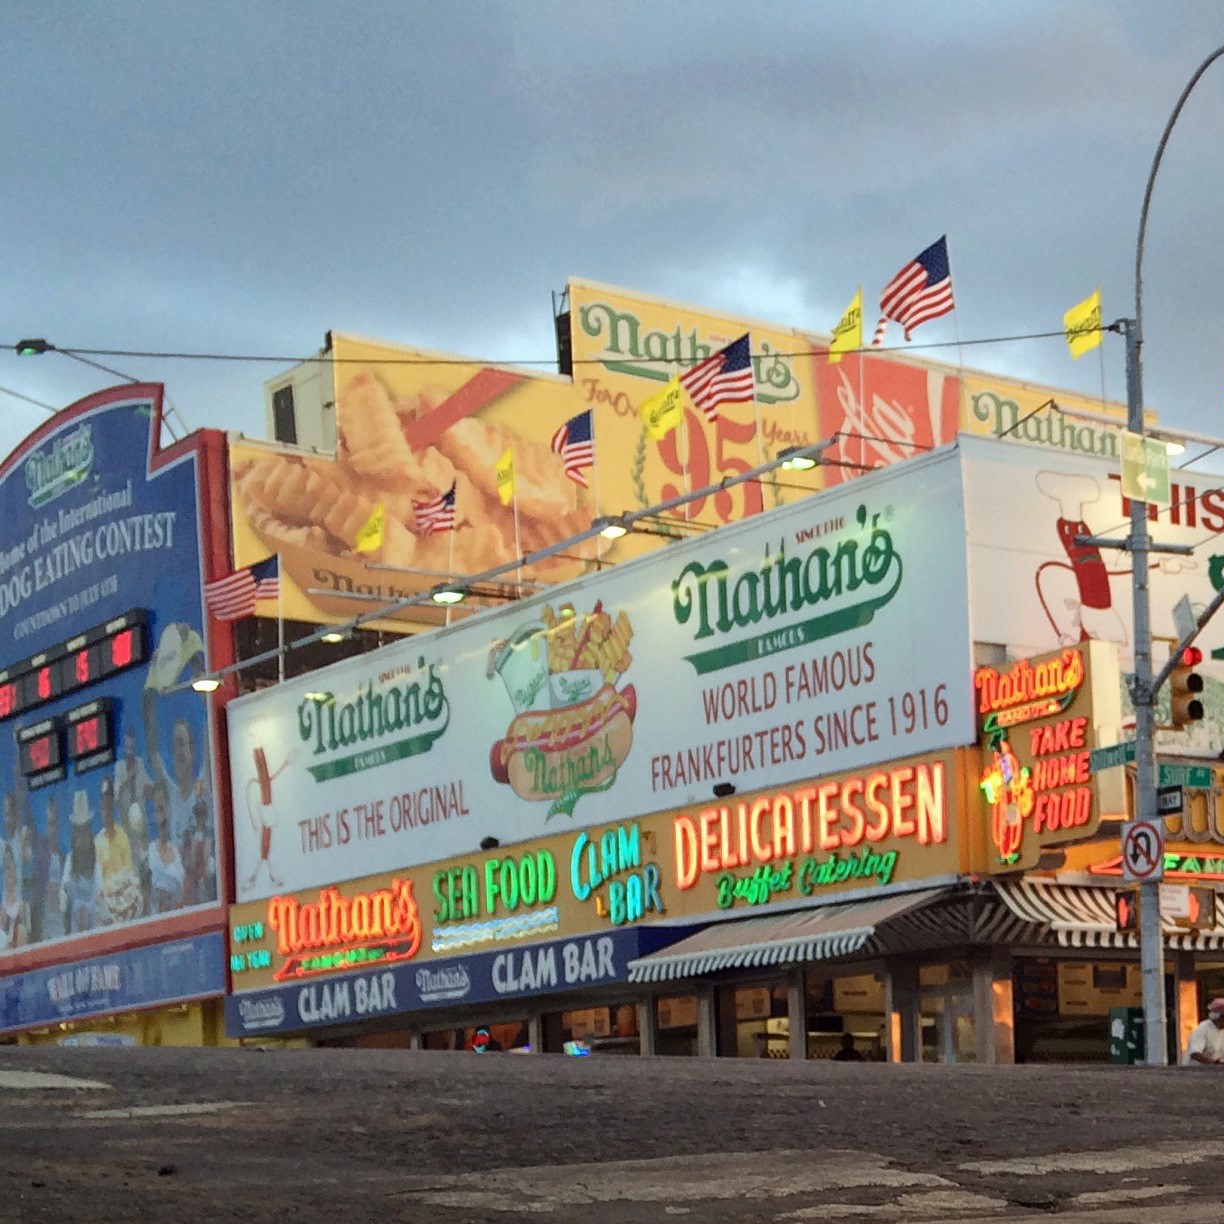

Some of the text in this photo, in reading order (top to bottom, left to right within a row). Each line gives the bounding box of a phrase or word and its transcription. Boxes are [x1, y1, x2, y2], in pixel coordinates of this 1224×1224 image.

[579, 303, 792, 389] Nath's
[762, 418, 810, 446] Years
[972, 391, 1118, 459] Nathan
[656, 407, 764, 525] 95
[34, 531, 94, 592] EATING
[95, 511, 176, 560] CONTEST
[671, 503, 894, 640] Nathan's
[298, 655, 444, 755] Nathan's
[702, 641, 877, 726] WORLD FAMOUS
[974, 649, 1084, 714] Nathan's
[651, 683, 949, 792] FRANKFURTERS SINCE 1916
[1030, 716, 1088, 757] TAKE
[1033, 751, 1091, 793] HOME
[298, 780, 470, 855] THIS IS THE ORIGINAL
[673, 759, 949, 890] DELICATESSEN
[1033, 787, 1092, 834] FOOD
[432, 849, 557, 924] SEA FOOD
[570, 822, 641, 901] CLAM
[609, 861, 664, 926] BAR
[715, 845, 899, 910] Buffet Catering
[267, 878, 418, 955] Nathan's
[298, 971, 397, 1024] CLAM BAR
[492, 936, 616, 994] CLAM BAR
